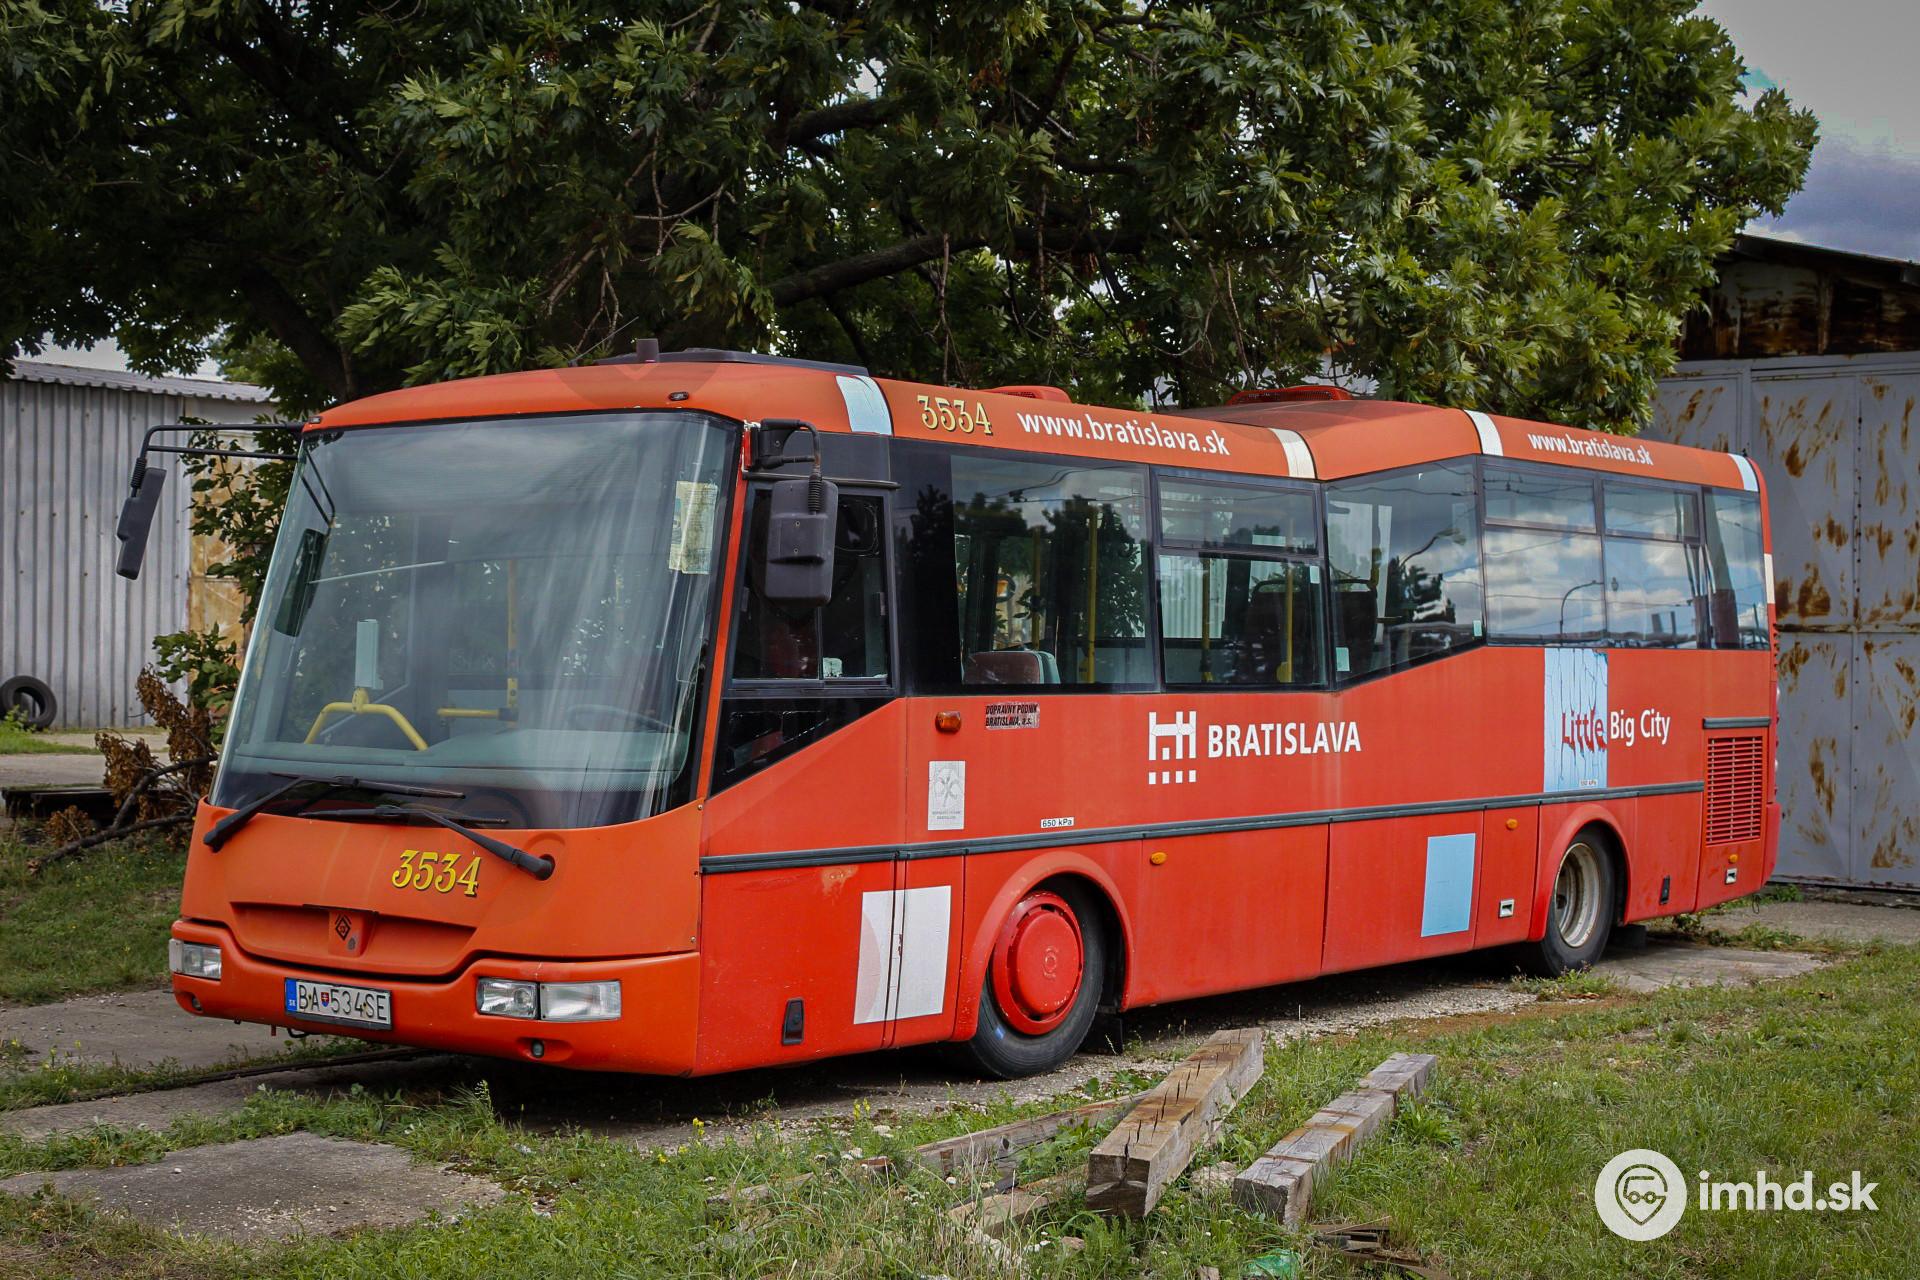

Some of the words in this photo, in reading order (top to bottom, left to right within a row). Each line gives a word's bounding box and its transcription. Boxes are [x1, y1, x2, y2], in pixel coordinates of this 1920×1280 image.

[916, 394, 993, 436] 3534
[1016, 411, 1231, 457] www.bratislava.sk
[1527, 433, 1654, 466] www.bratislava.sk
[1207, 721, 1362, 758] BRATISLAVA
[1561, 708, 1608, 753] Little
[1610, 709, 1636, 747] Big
[1640, 708, 1671, 745] City
[1042, 819, 1057, 828] 650
[1058, 818, 1073, 826] kPa
[391, 849, 482, 897] 3534
[298, 984, 320, 1010] BA
[330, 988, 388, 1021] 534SE
